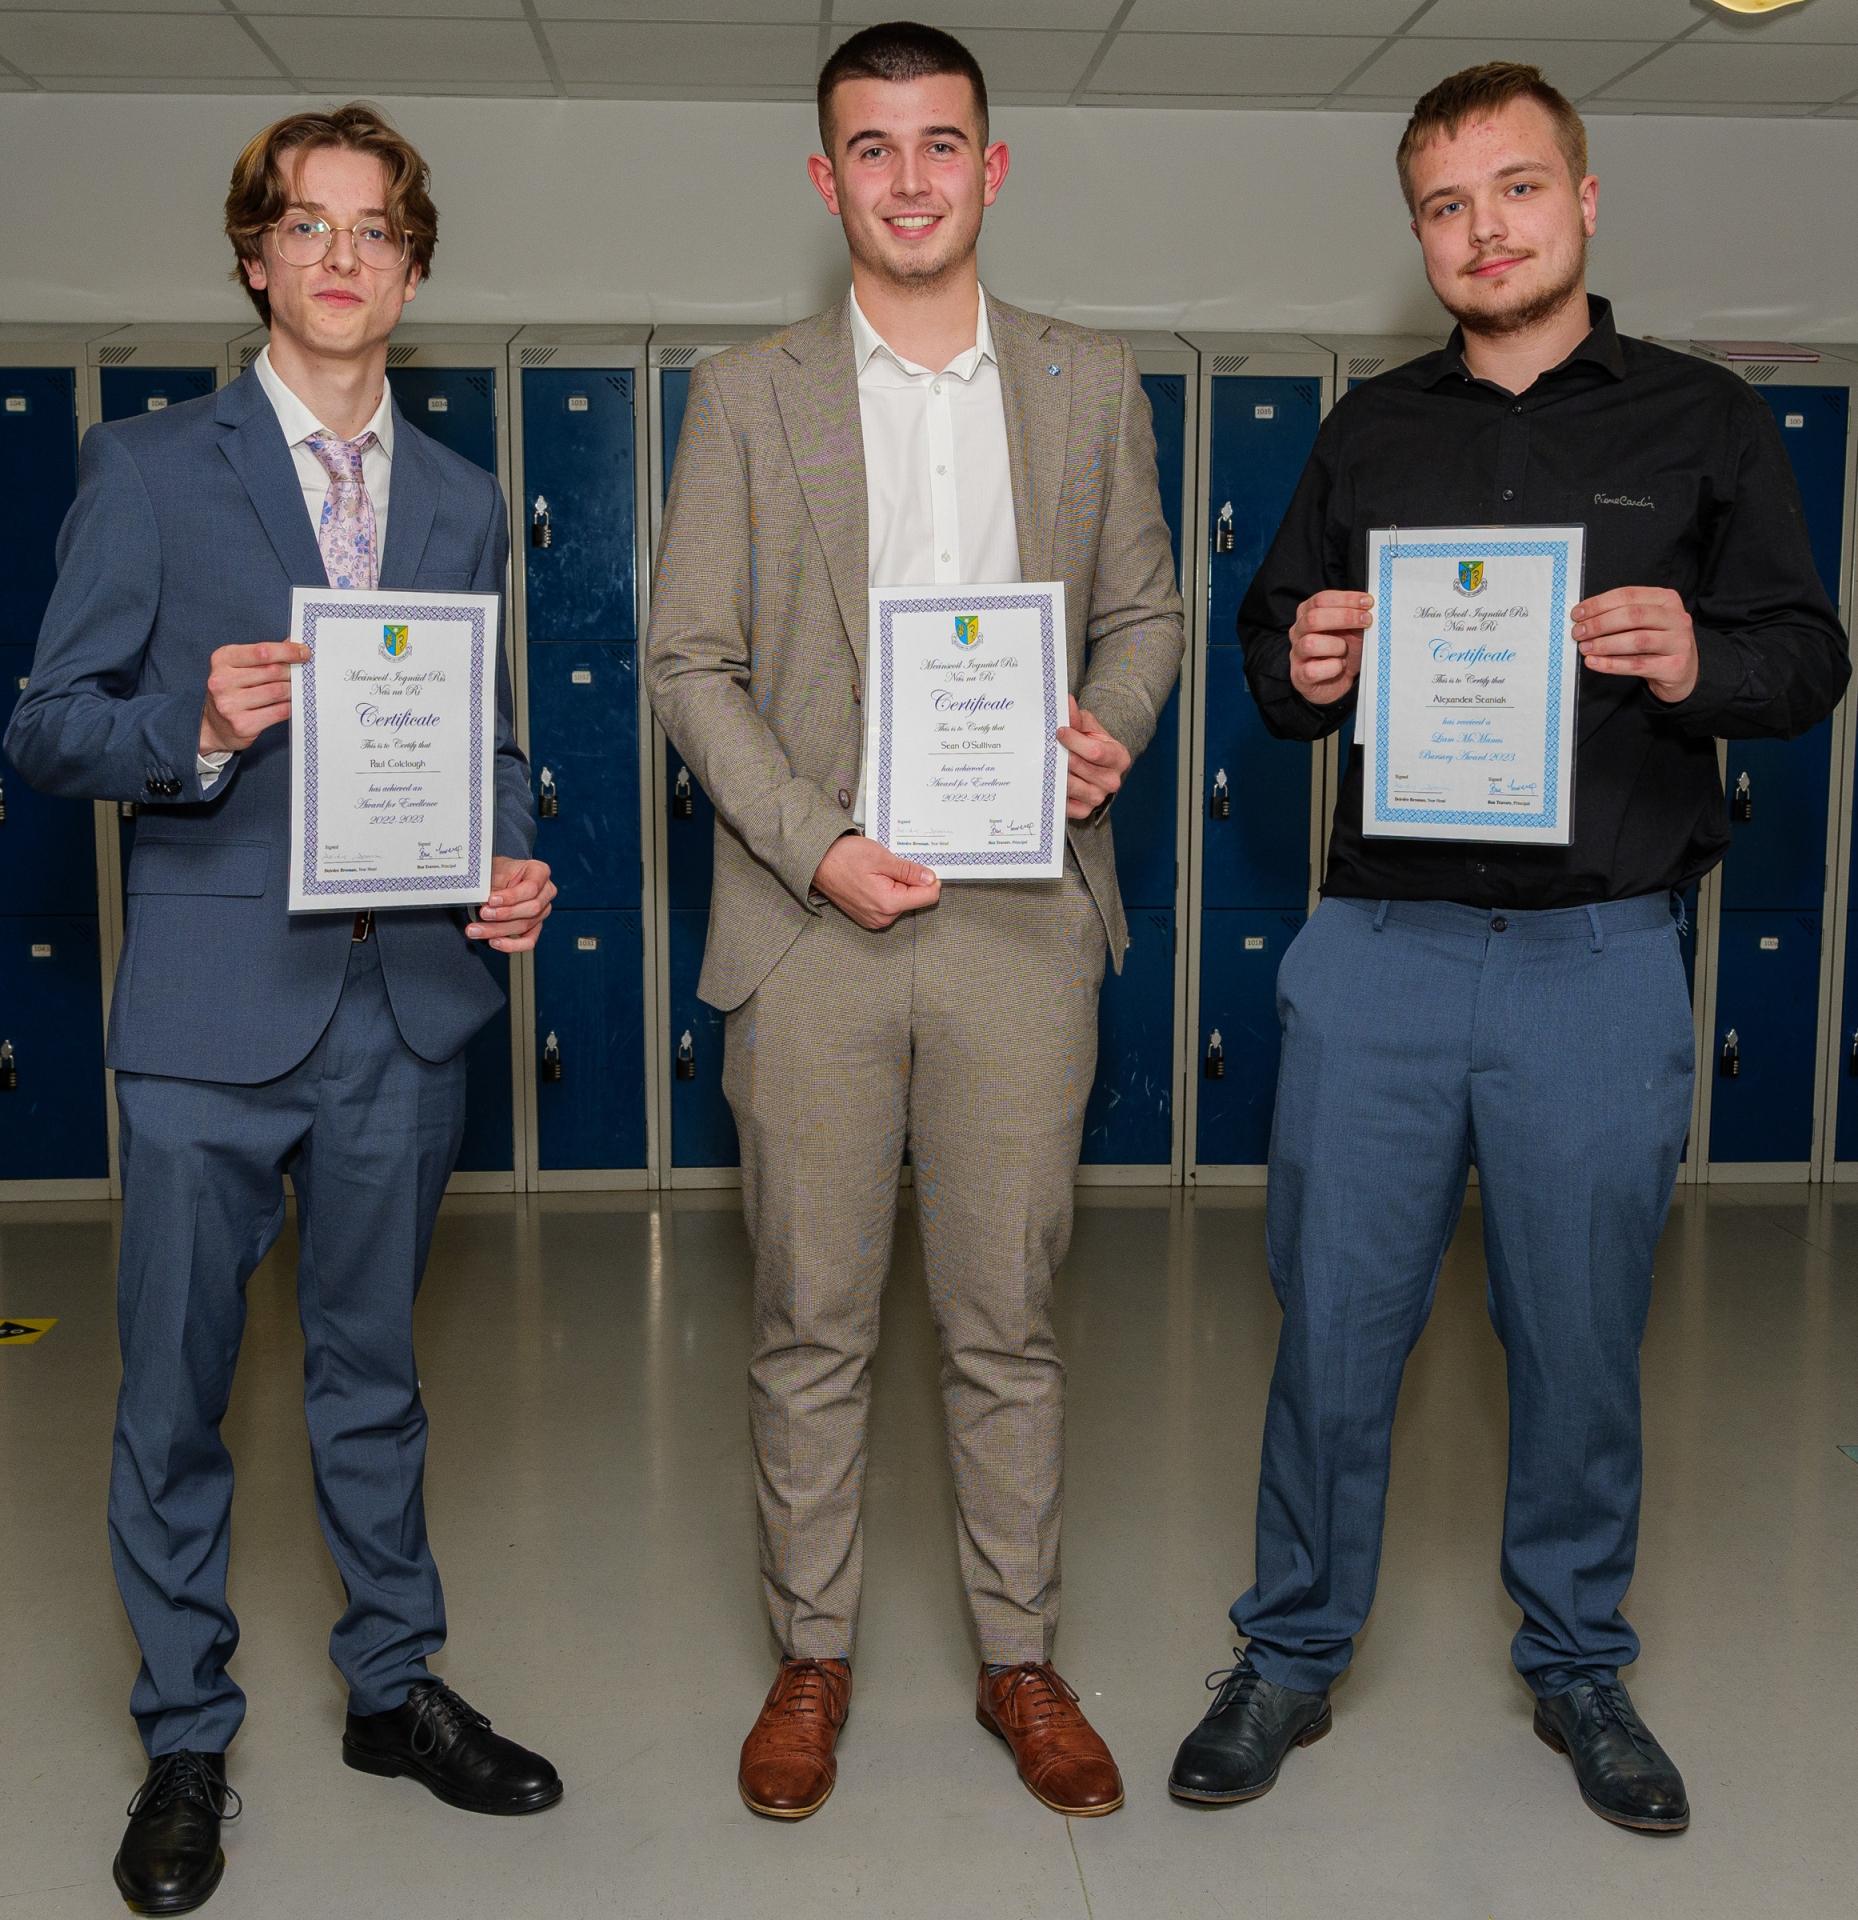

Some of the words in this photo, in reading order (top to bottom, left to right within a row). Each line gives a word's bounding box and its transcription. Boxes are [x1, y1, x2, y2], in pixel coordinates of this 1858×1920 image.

[1428, 638, 1516, 669] Certificate
[1432, 674, 1447, 684] This
[1464, 673, 1490, 687] Certify
[1491, 676, 1505, 684] that
[931, 689, 1014, 718] Certificate
[1433, 694, 1473, 705] Alexander
[355, 702, 440, 734] Certificate
[1442, 717, 1454, 725] has
[1456, 717, 1485, 726] received
[934, 722, 949, 732] This
[965, 722, 991, 734] Certify
[992, 723, 1005, 731] that
[1431, 731, 1455, 743] Liam
[360, 739, 376, 749] This
[392, 738, 417, 752] Certify
[418, 740, 431, 749] that
[940, 741, 959, 750] Sean
[962, 740, 1002, 750] O'Sullivan
[1456, 750, 1487, 761] Award
[1488, 752, 1516, 762] 2023
[370, 759, 385, 768] Paul
[388, 759, 426, 769] Colclough
[941, 764, 954, 772] has
[955, 764, 984, 772] achieved
[368, 783, 381, 792] has
[382, 783, 412, 792] achieved
[926, 777, 956, 788] Award
[956, 779, 968, 790] for
[970, 777, 1010, 788] Excellence
[354, 798, 385, 809] Award
[384, 800, 396, 810] for
[398, 797, 438, 809] Excellence
